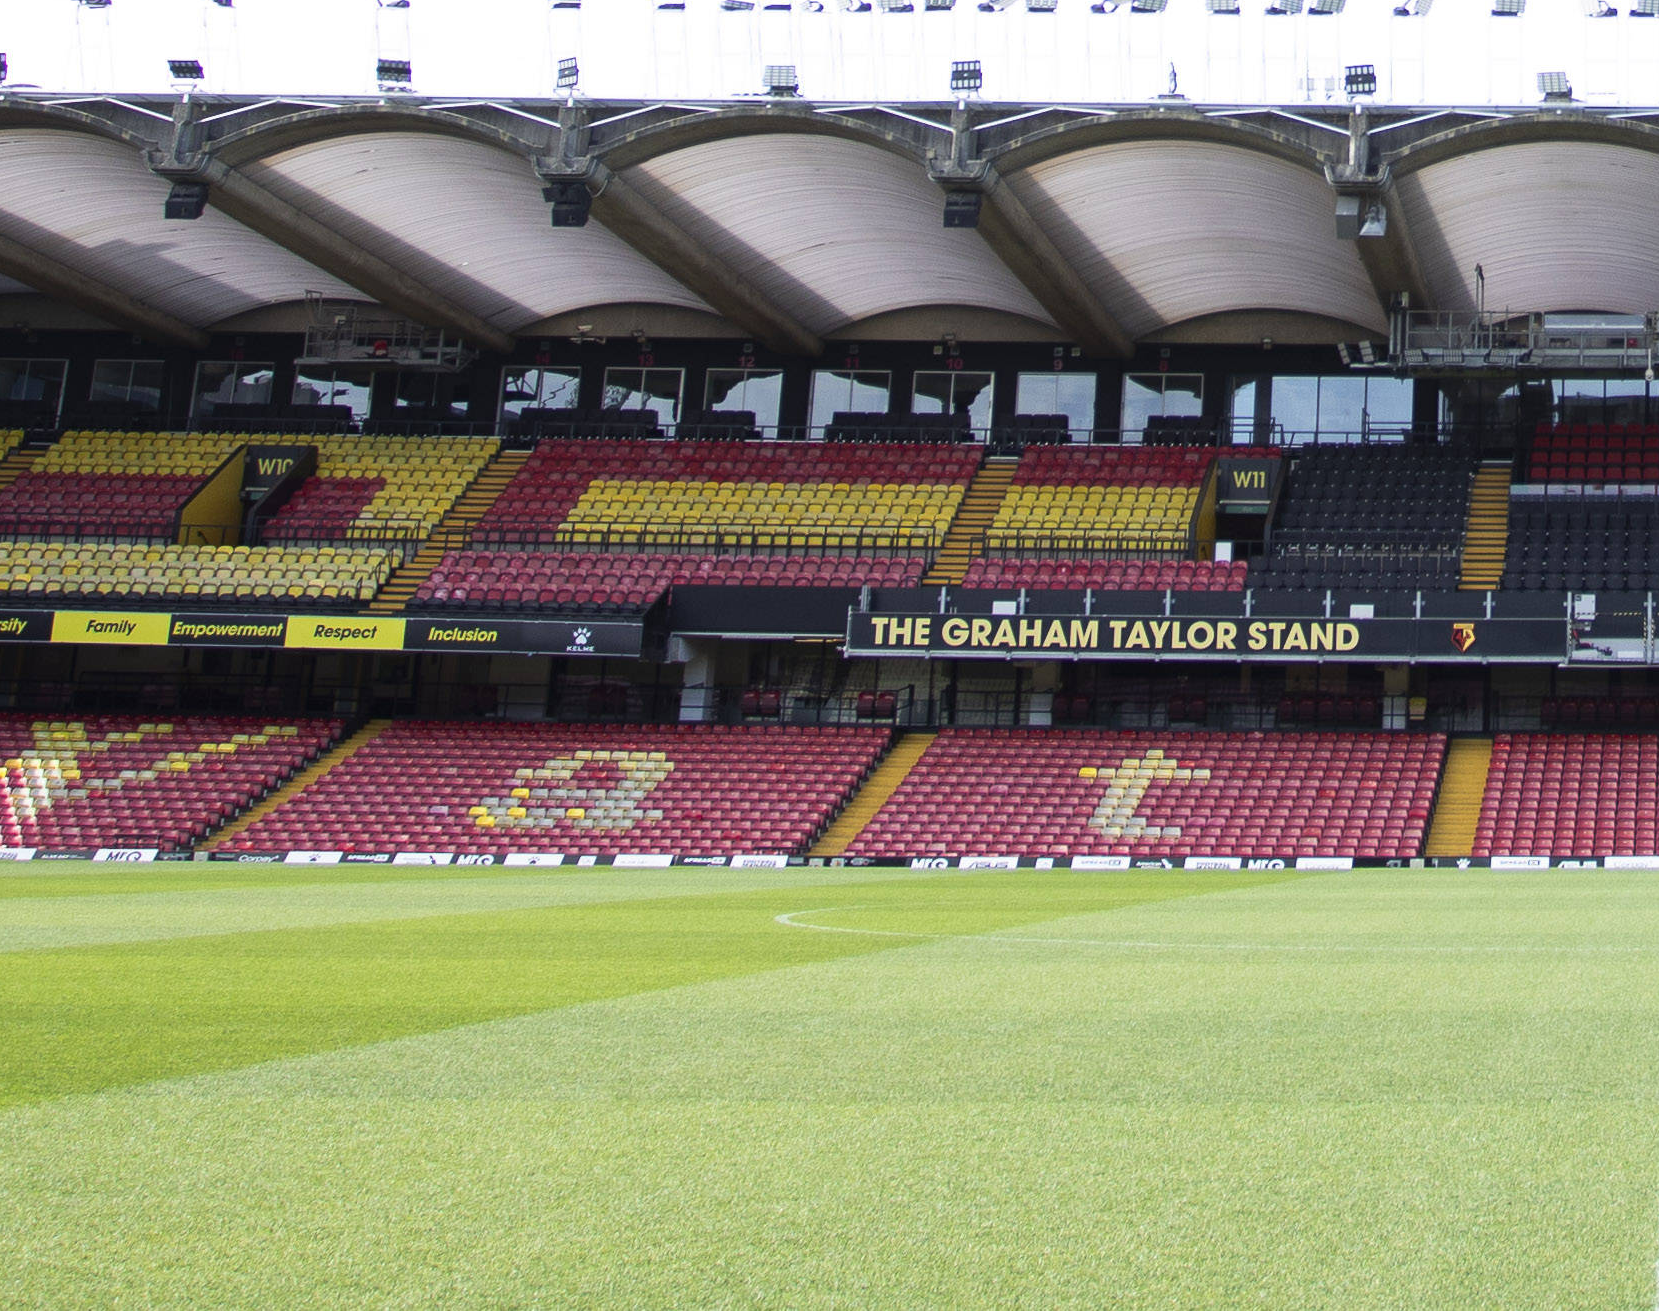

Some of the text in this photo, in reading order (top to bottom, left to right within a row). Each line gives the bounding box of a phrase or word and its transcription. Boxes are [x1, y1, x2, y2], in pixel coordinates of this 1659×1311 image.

[1233, 471, 1266, 489] W11
[85, 619, 137, 636] Family
[172, 621, 283, 639] Empowerment
[313, 624, 378, 641] Respect
[427, 626, 498, 643] Inclusion
[871, 617, 1360, 651] THE GRAHAM TAYLOR STAND
